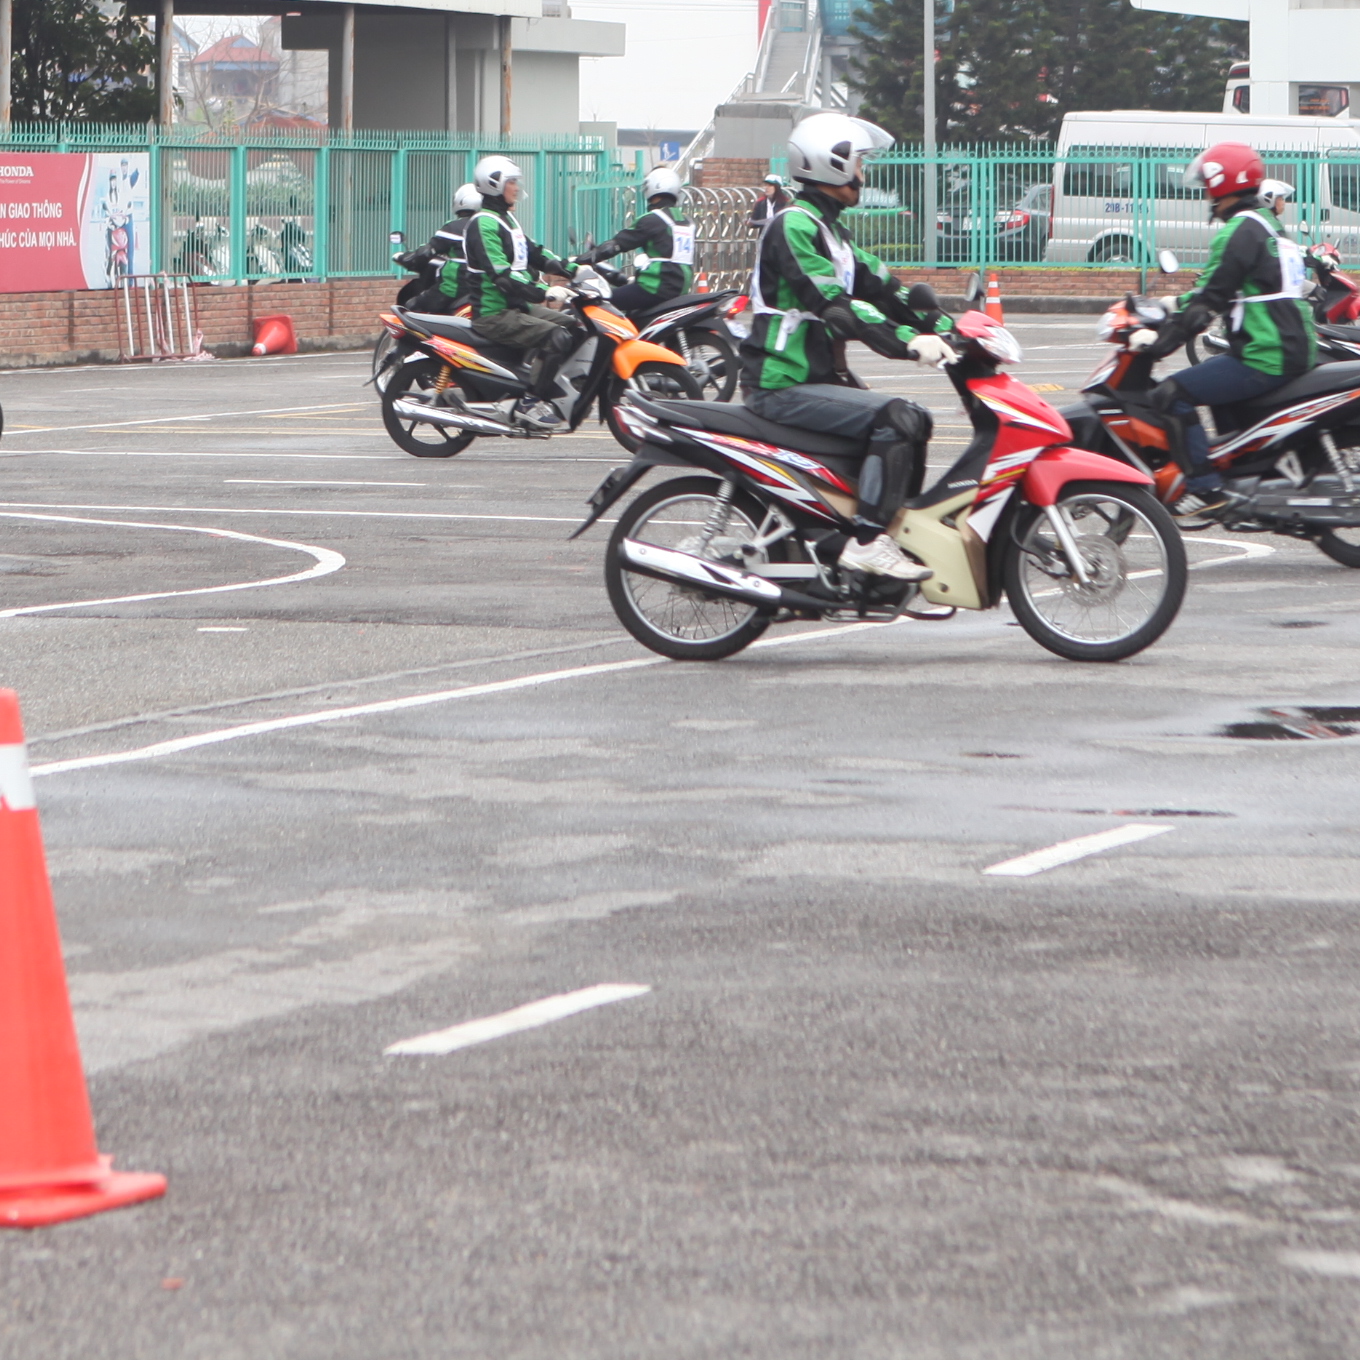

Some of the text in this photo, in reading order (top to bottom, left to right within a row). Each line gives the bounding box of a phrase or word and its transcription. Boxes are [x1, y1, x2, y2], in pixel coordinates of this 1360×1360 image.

[8, 203, 30, 219] GIAO
[32, 199, 62, 218] THÔNG
[18, 228, 37, 248] CỦA
[39, 231, 55, 251] MỌI
[57, 228, 77, 247] NHÀ.
[675, 236, 691, 254] 14
